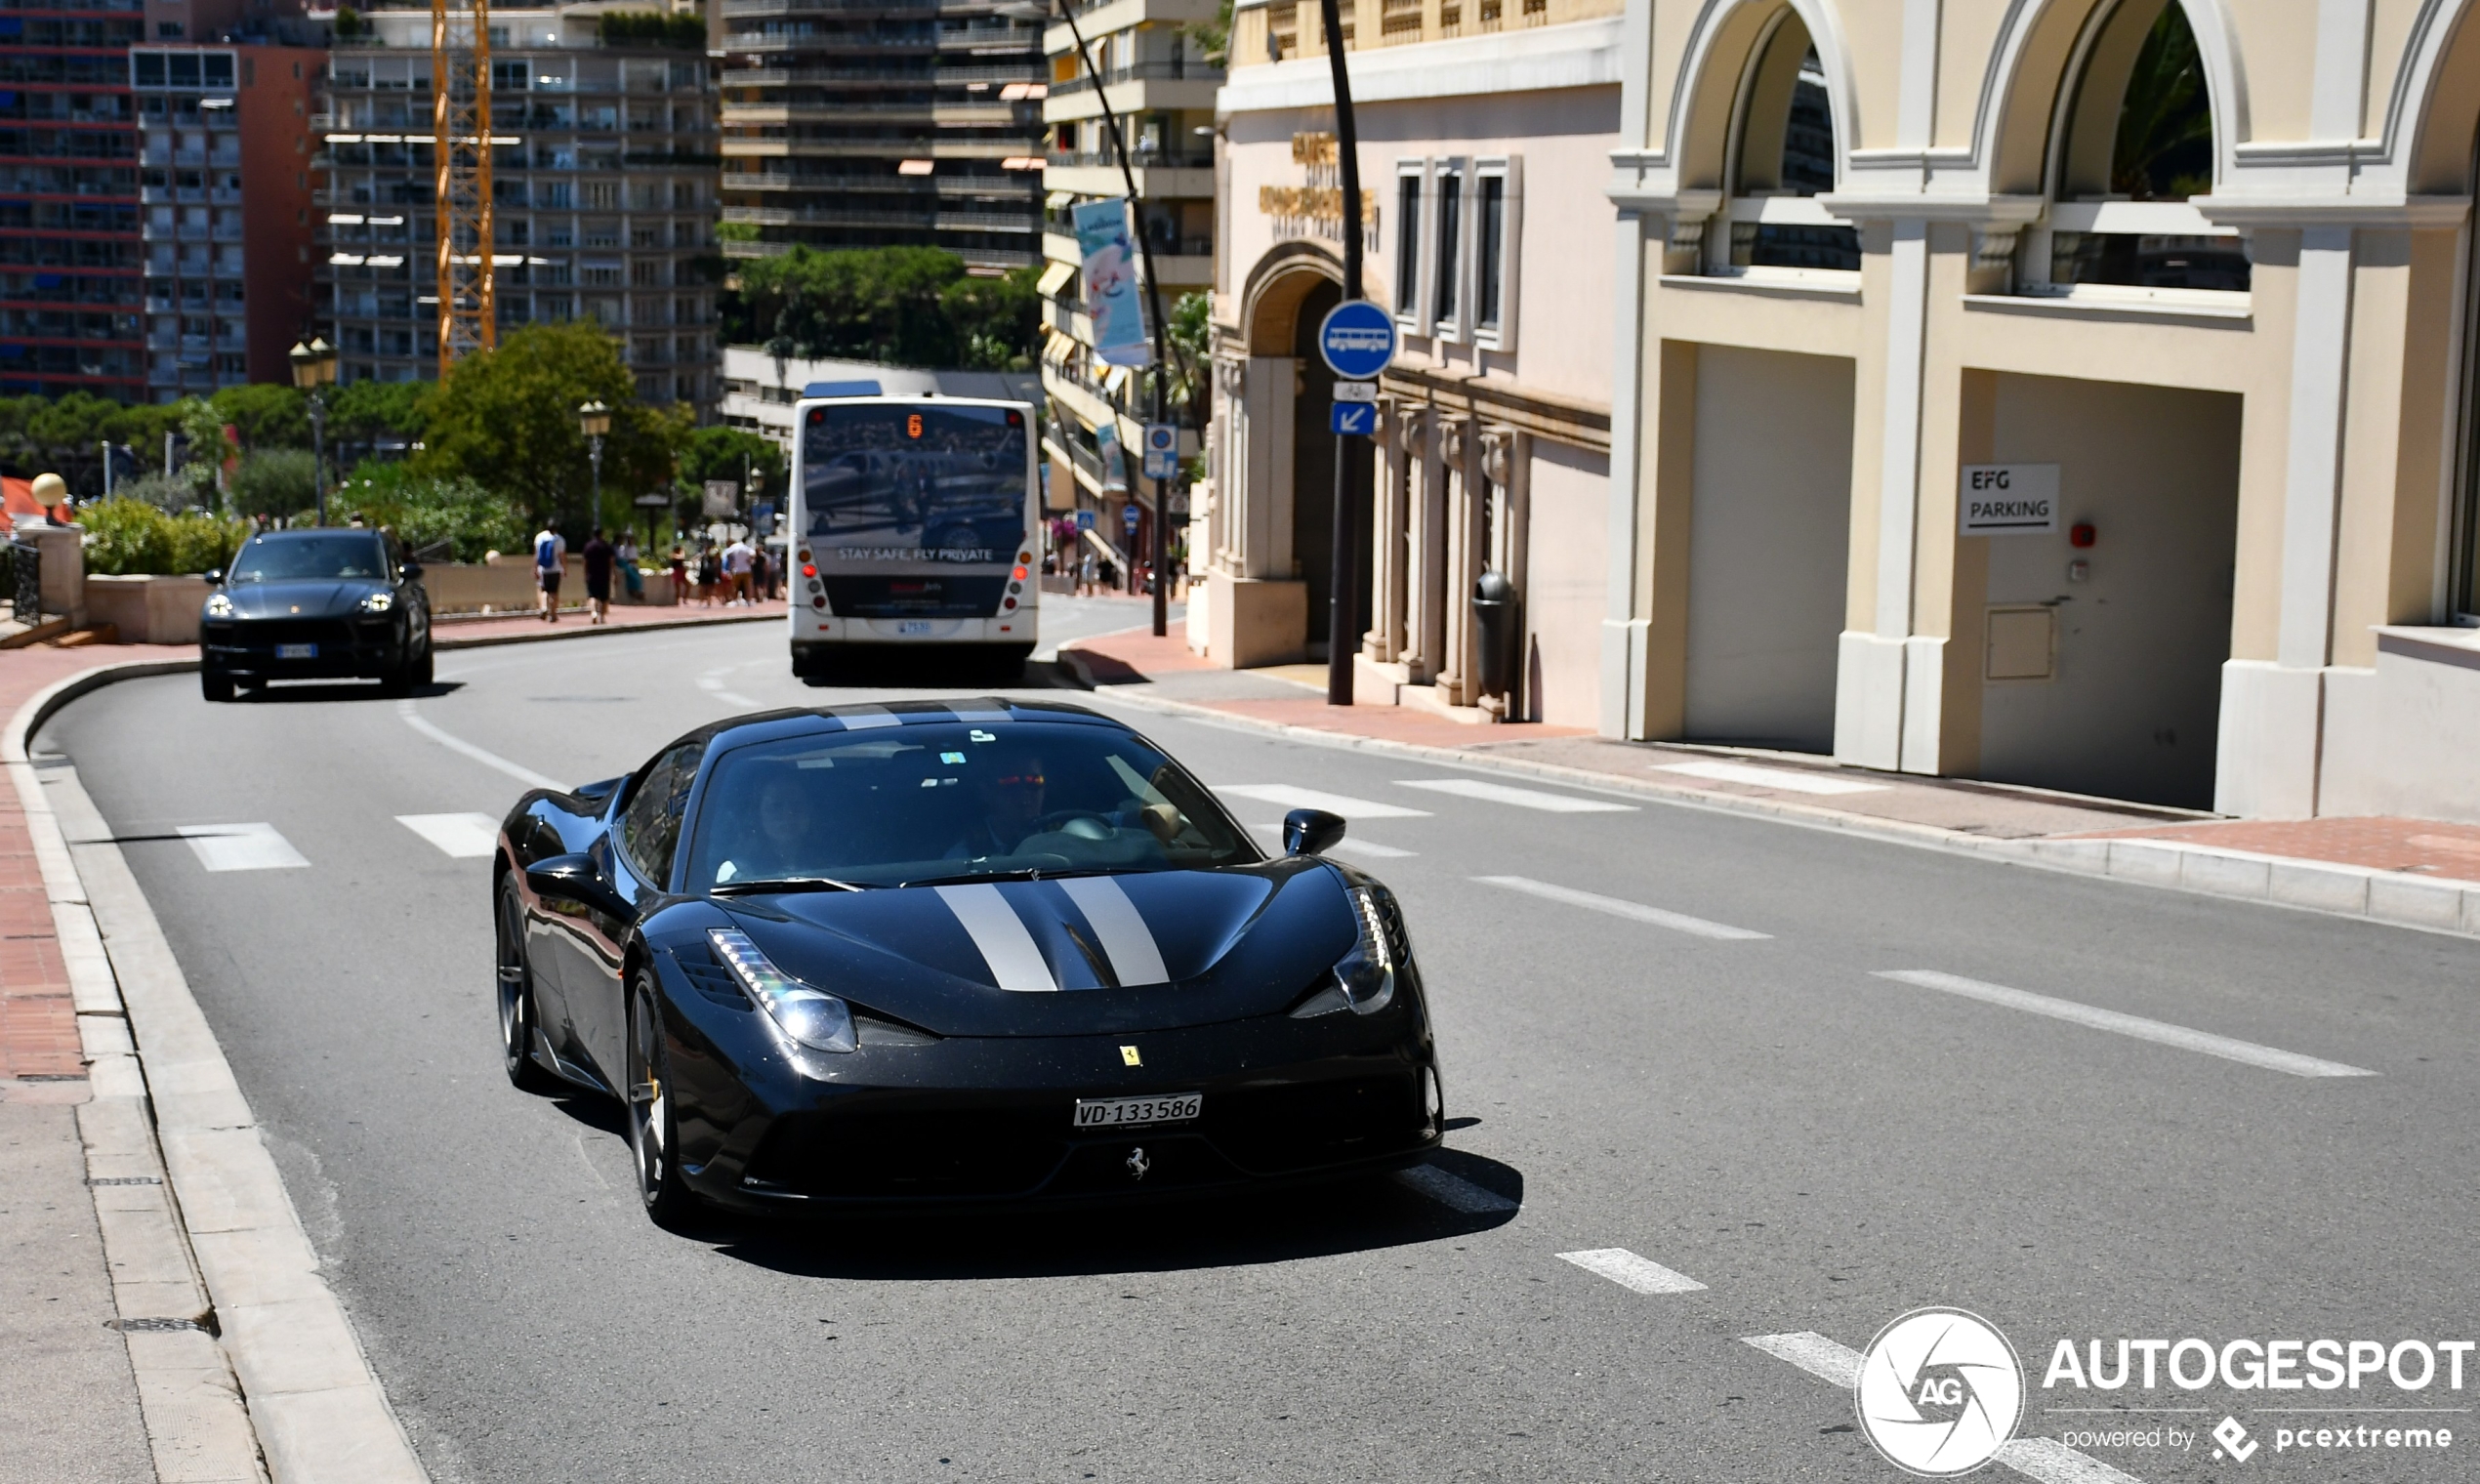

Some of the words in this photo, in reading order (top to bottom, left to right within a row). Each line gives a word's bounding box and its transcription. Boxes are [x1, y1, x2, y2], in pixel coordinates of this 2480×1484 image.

[907, 414, 923, 438] 6
[1971, 470, 2009, 489] EFG
[1970, 499, 2049, 517] PARKING
[839, 548, 873, 560] STAY
[914, 548, 936, 560] FLY
[938, 548, 994, 561] PRIVATE
